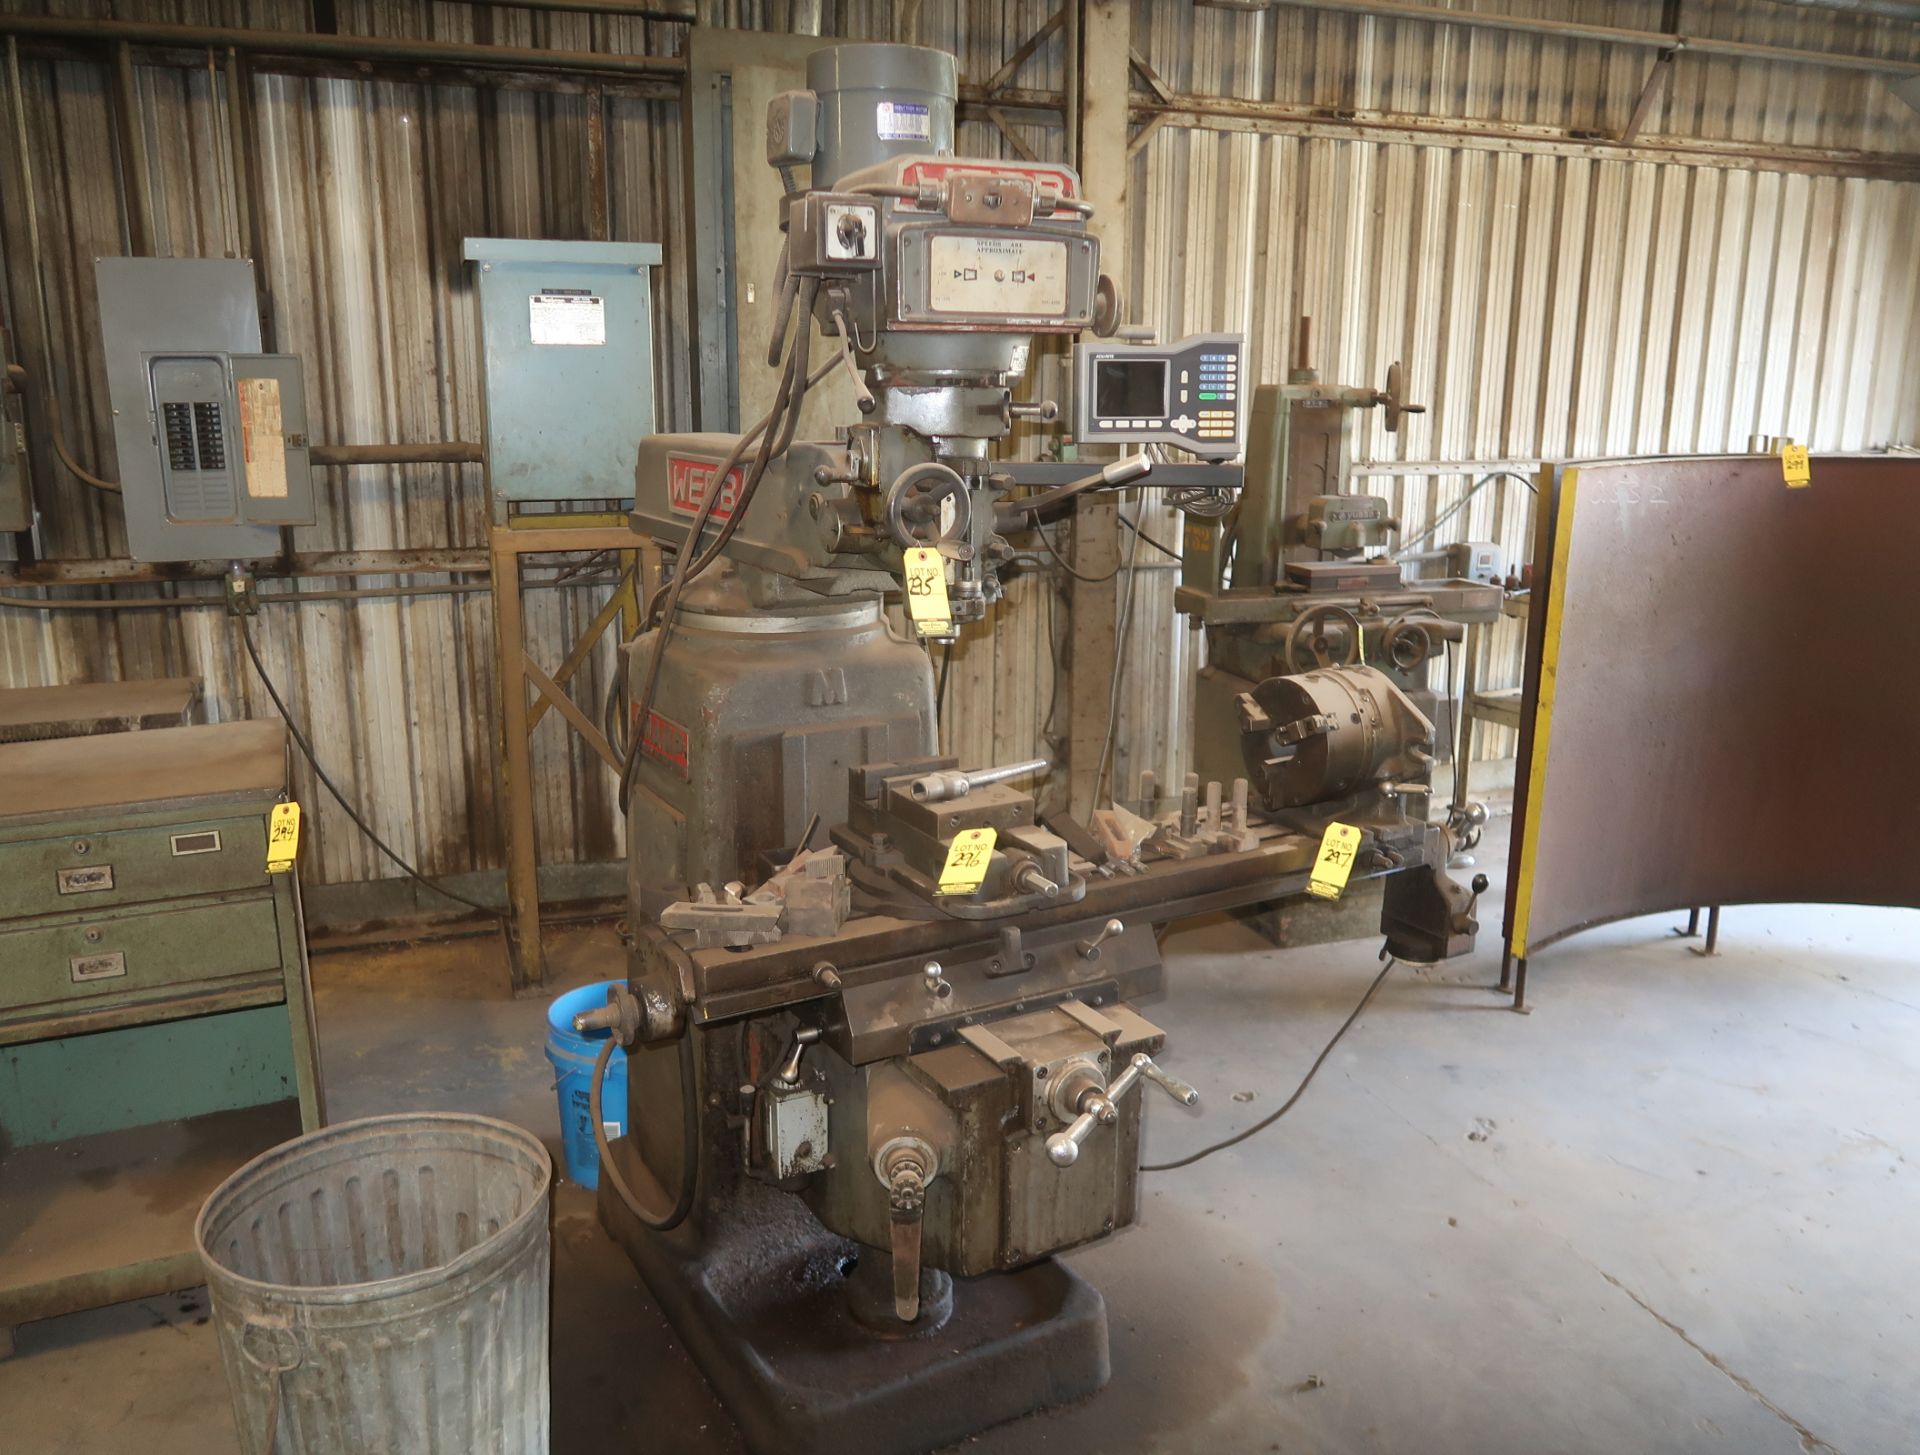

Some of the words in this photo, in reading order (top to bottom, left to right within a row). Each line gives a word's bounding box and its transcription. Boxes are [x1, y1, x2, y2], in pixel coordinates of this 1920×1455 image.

[909, 567, 925, 582] LOT
[273, 818, 285, 828] LOT
[271, 825, 296, 843] 294
[954, 844, 973, 852] LOT
[1325, 838, 1341, 849] LOT
[950, 850, 982, 868] 296
[1323, 848, 1353, 868] 297
